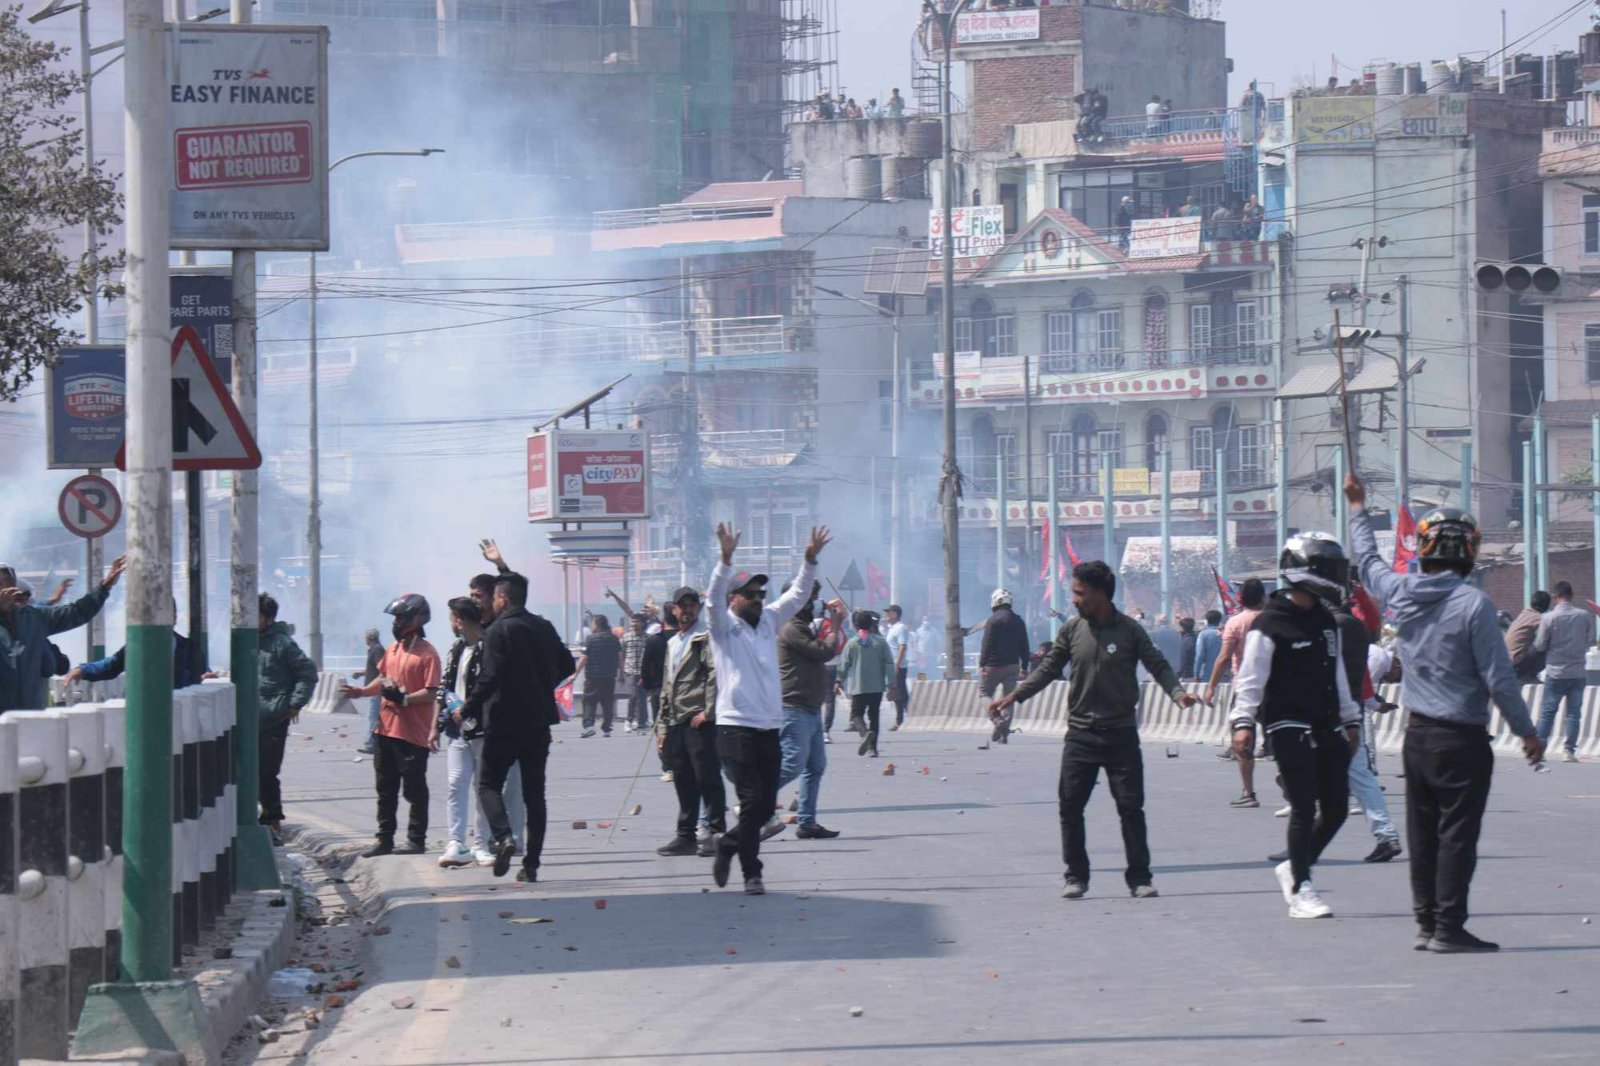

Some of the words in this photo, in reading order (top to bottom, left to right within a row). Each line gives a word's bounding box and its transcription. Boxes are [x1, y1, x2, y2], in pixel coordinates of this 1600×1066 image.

[213, 69, 242, 81] TVS
[171, 84, 222, 103] EASY
[229, 86, 315, 105] FINANCE
[186, 131, 297, 159] GUARANTOR
[188, 160, 220, 180] NOT
[224, 155, 301, 179] REQUIRED
[193, 211, 206, 220] ON
[209, 211, 229, 220] ANY
[232, 211, 249, 220] TVS
[252, 211, 295, 221] VEHICLES
[971, 215, 1002, 237] Flex
[180, 294, 202, 306] GET
[170, 307, 195, 318] PARE
[197, 305, 231, 317] PARTS
[68, 393, 123, 407] LIFETIME
[586, 467, 640, 482] cityPAY
[78, 488, 107, 524] P
